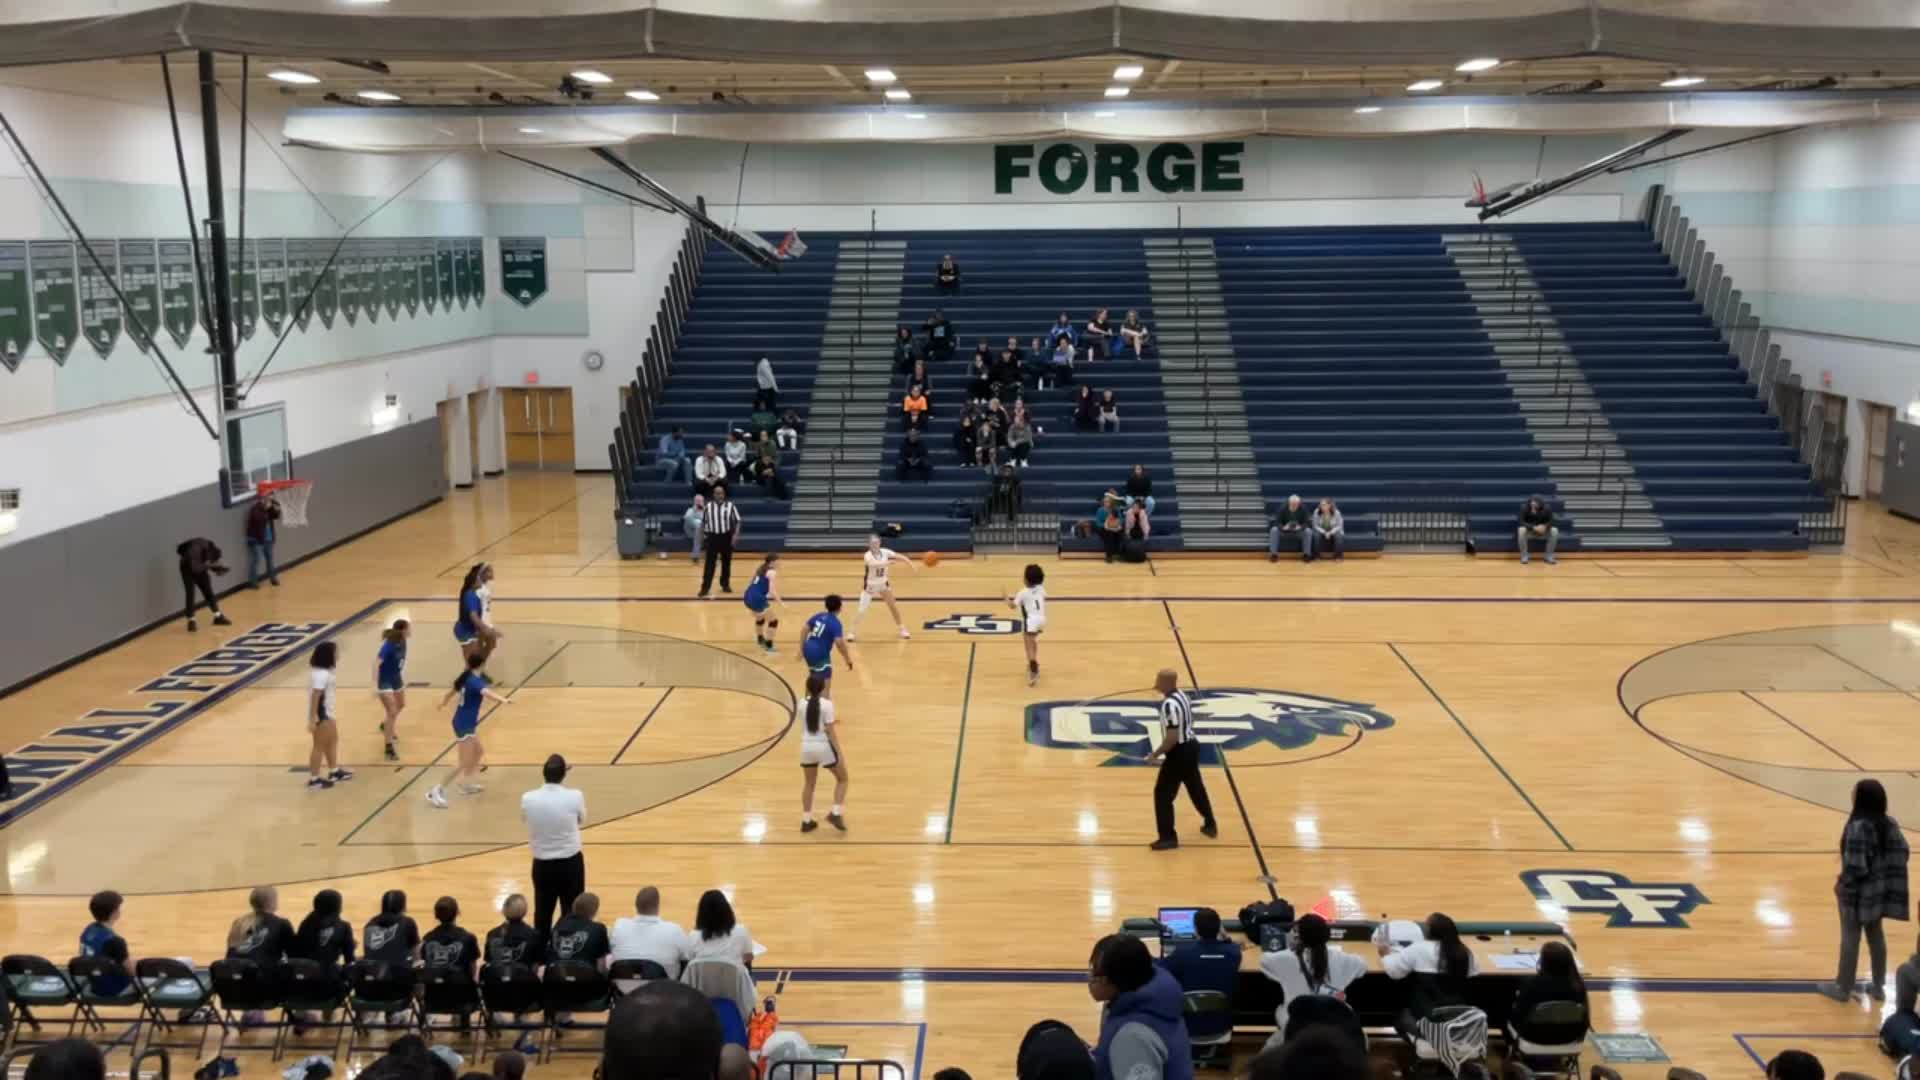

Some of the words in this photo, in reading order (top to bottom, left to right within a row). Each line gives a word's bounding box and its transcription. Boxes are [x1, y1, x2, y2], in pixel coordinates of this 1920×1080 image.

[994, 142, 1245, 194] FORGE
[132, 621, 335, 695] FORGE
[1524, 871, 1702, 927] CF
